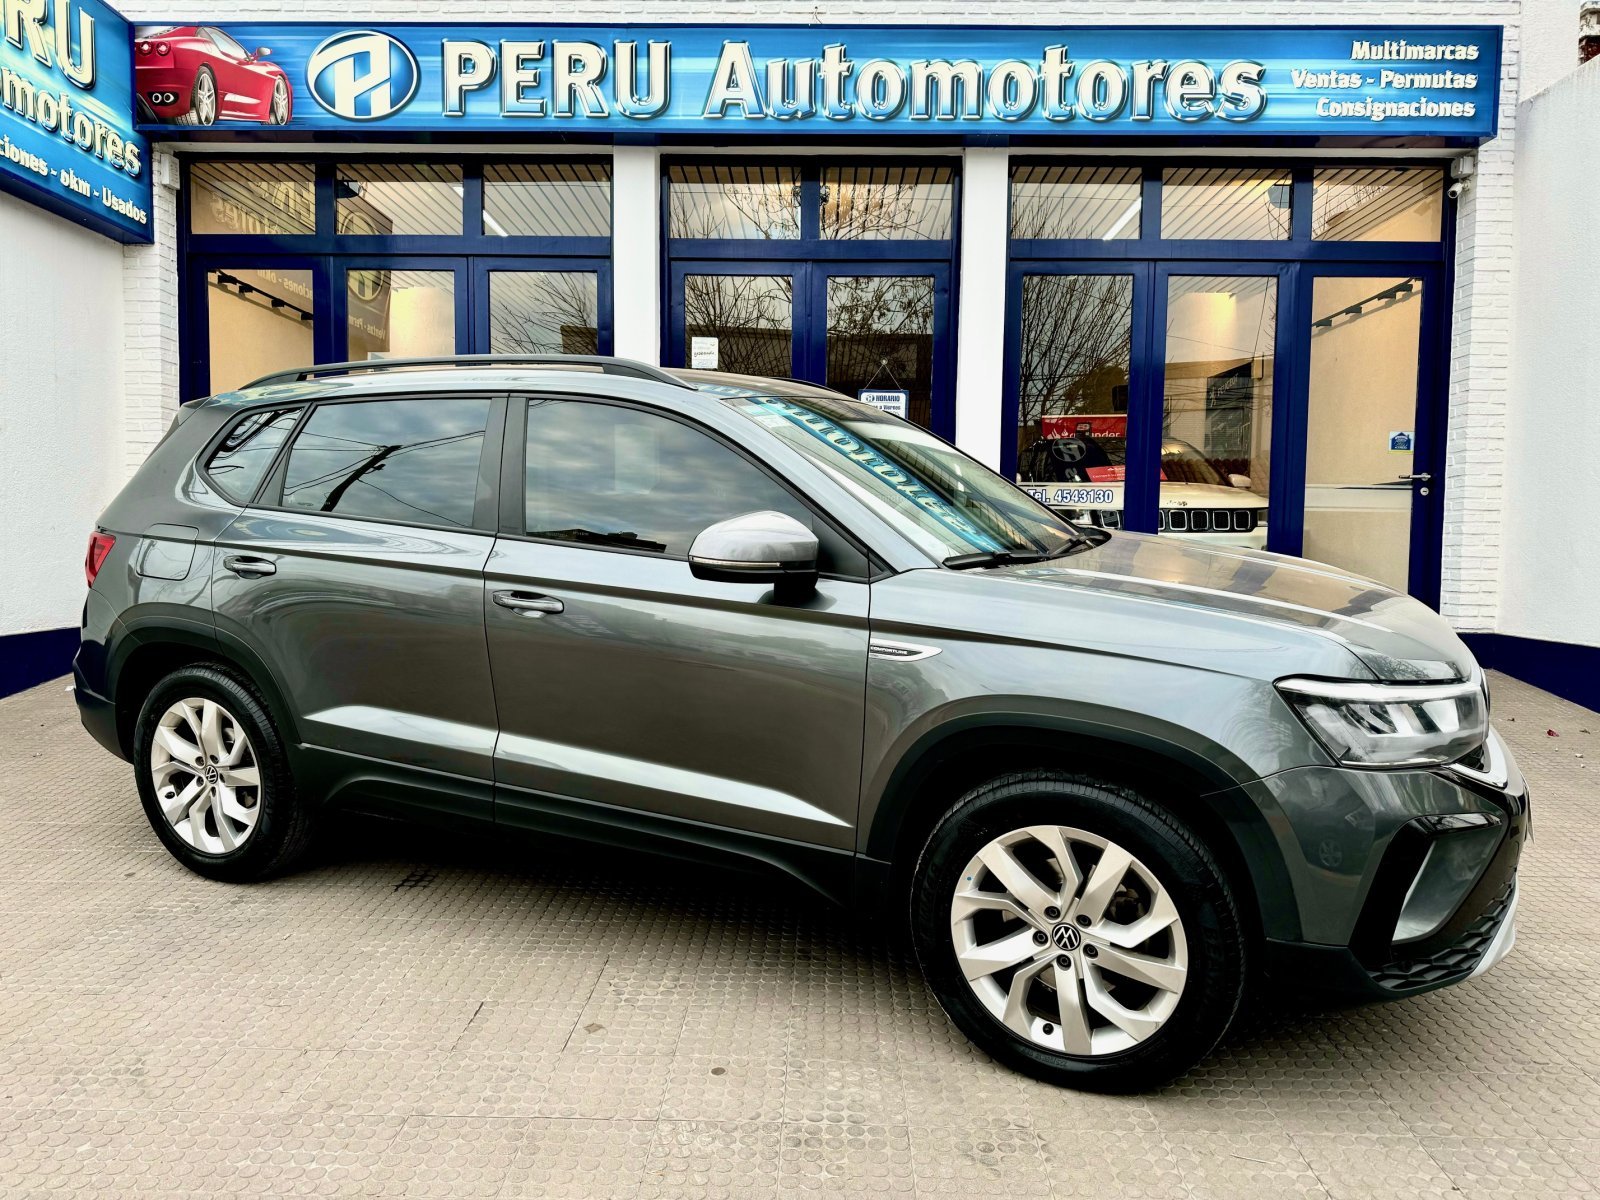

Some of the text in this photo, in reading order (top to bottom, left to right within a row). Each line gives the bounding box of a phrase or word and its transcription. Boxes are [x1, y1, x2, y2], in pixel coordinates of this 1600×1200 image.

[1351, 39, 1480, 60] Multimarcas
[442, 38, 1267, 122] PERU Automotores
[1291, 69, 1363, 88] Ventas
[1380, 69, 1478, 89] Permutas
[1316, 96, 1476, 121] Consignaciones
[102, 185, 147, 224] Usados
[1027, 488, 1113, 503] Tel. 4543130
